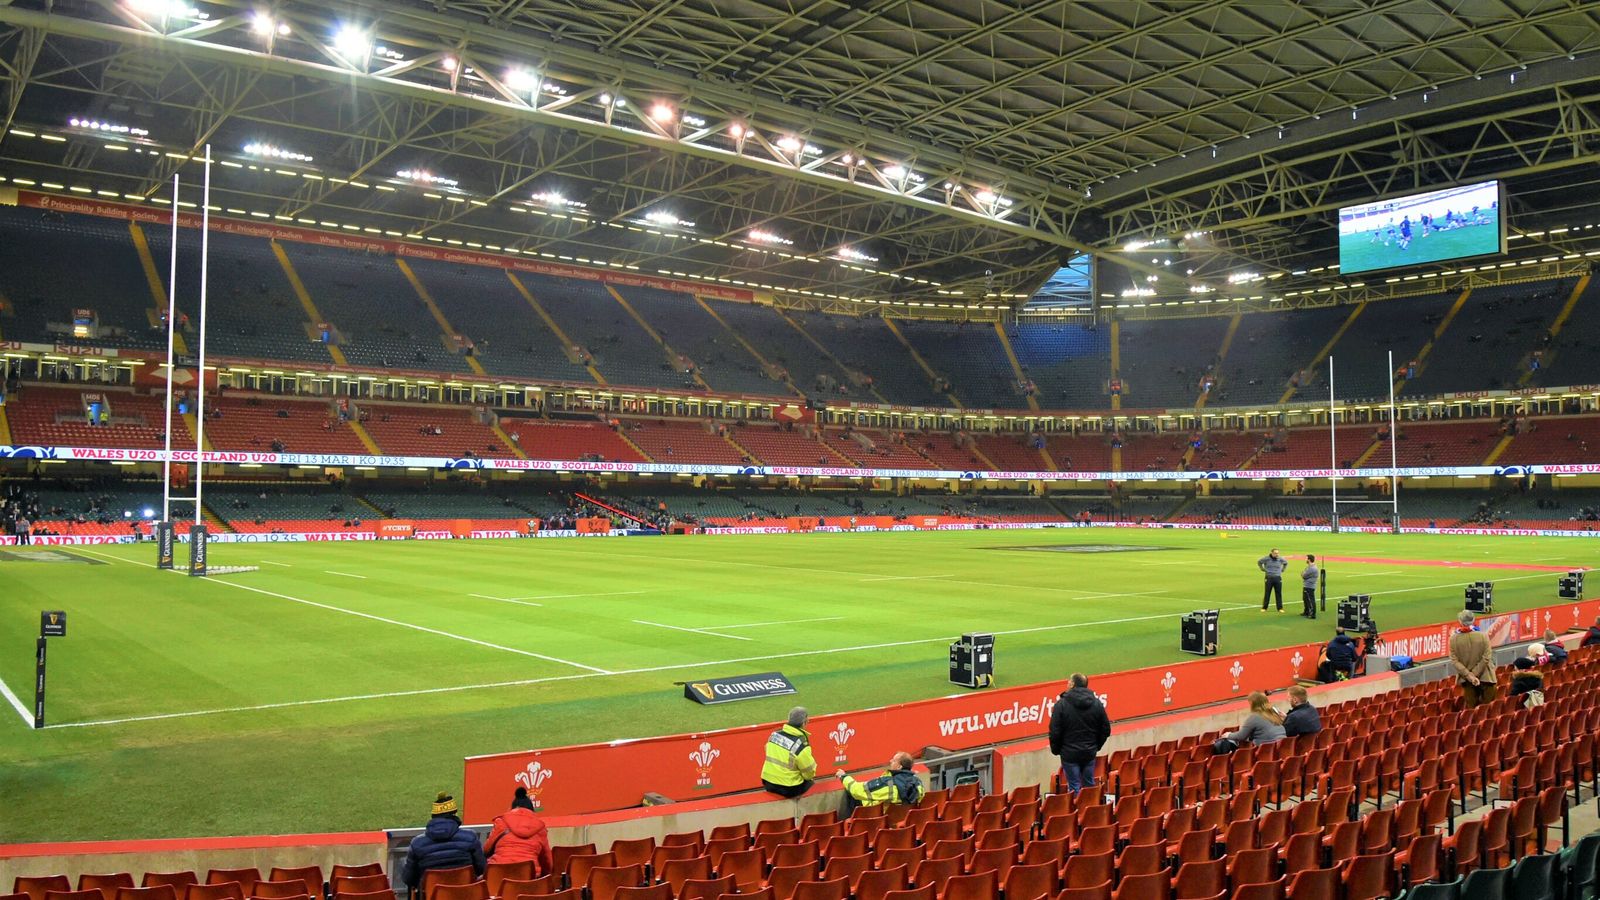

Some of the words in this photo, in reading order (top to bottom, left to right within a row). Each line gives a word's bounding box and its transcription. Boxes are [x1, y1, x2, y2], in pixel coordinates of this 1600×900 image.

[51, 200, 94, 213] Principality
[54, 344, 103, 356] ISUZU
[1455, 390, 1489, 399] ISUZU
[1510, 387, 1546, 396] ISUZU
[72, 448, 124, 459] WALES
[128, 450, 156, 460] U20
[251, 453, 277, 462] U20
[280, 454, 300, 463] FRI
[305, 455, 318, 464] 13
[320, 456, 350, 464] MAR
[359, 456, 376, 465] KO
[494, 460, 530, 468] WALES
[532, 460, 552, 469] U20
[562, 461, 614, 470] SCOTLAND
[616, 462, 634, 471] U20
[636, 464, 650, 472] FRI
[664, 464, 684, 472] MAR
[772, 466, 798, 474] WALES
[800, 467, 814, 475] U20
[821, 468, 860, 476] SCOTLAND
[1544, 464, 1584, 473] WALES
[1410, 636, 1422, 656] HOT
[1424, 634, 1442, 654] DOGS
[714, 678, 787, 696] GUINNESS
[696, 778, 711, 786] WRU
